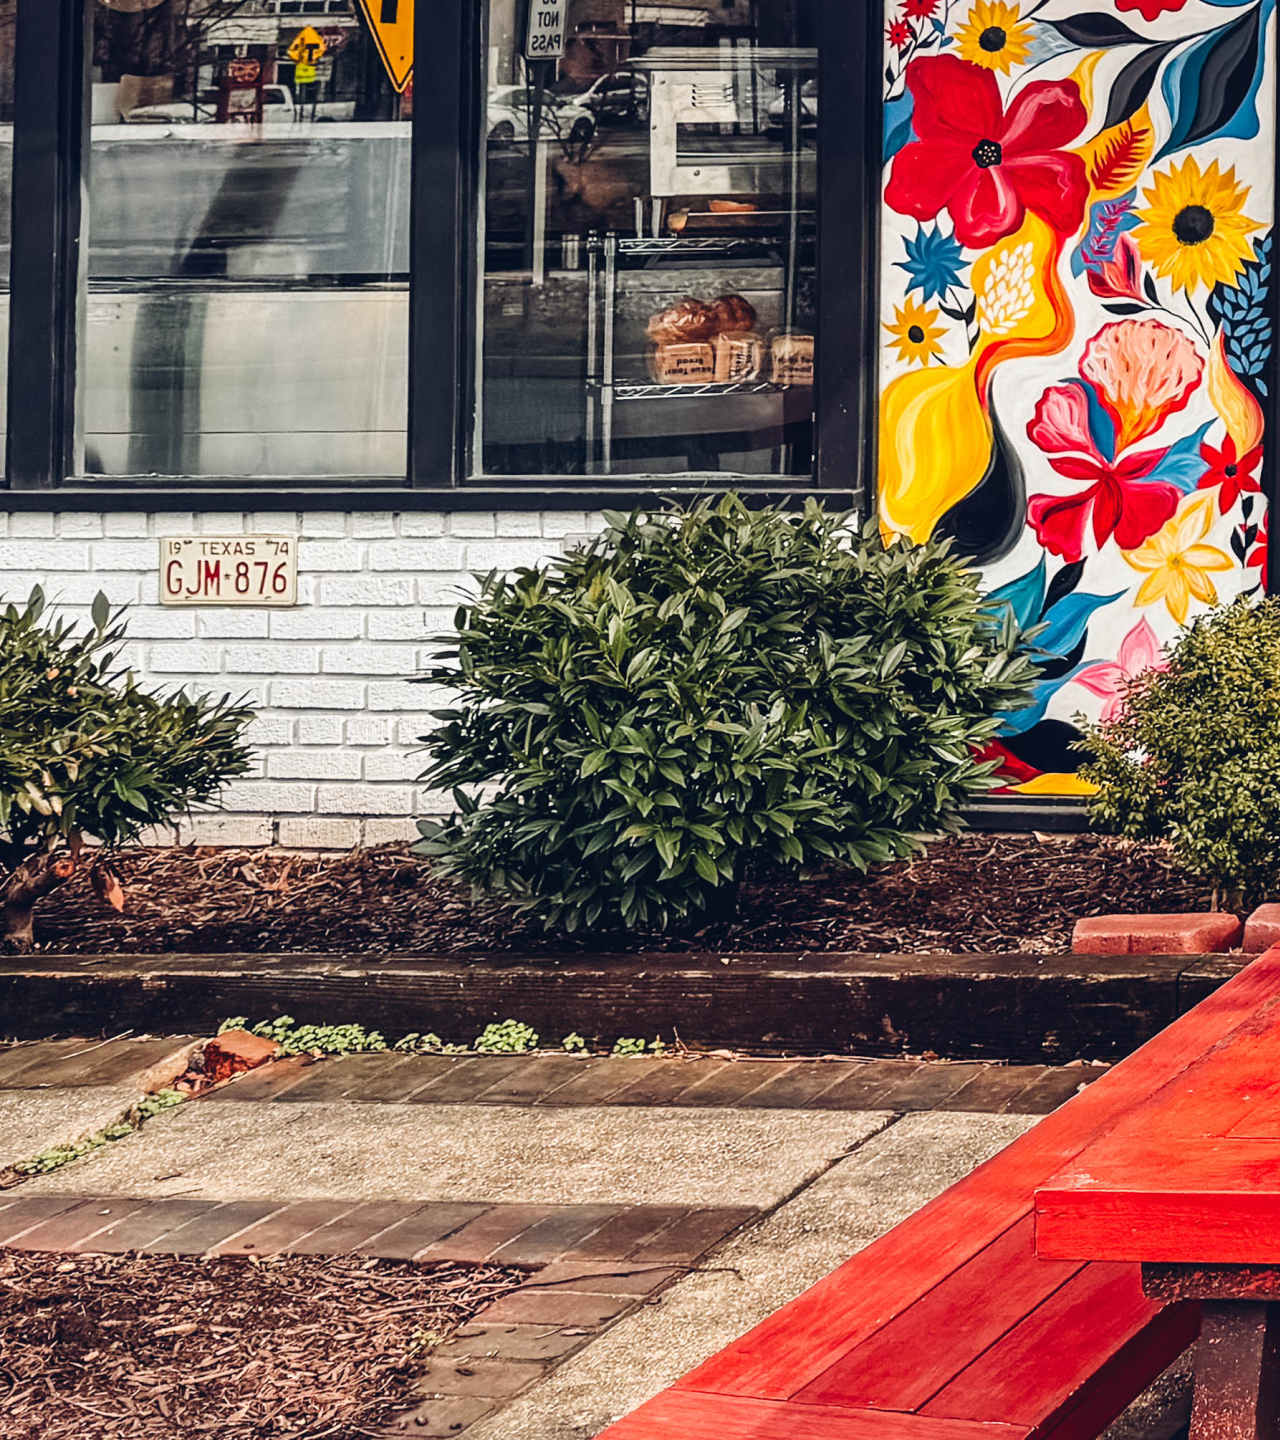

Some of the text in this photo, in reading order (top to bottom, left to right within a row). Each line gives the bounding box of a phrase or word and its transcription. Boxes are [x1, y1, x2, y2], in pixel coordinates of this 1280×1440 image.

[169, 542, 289, 556] 19 TEXAS 74
